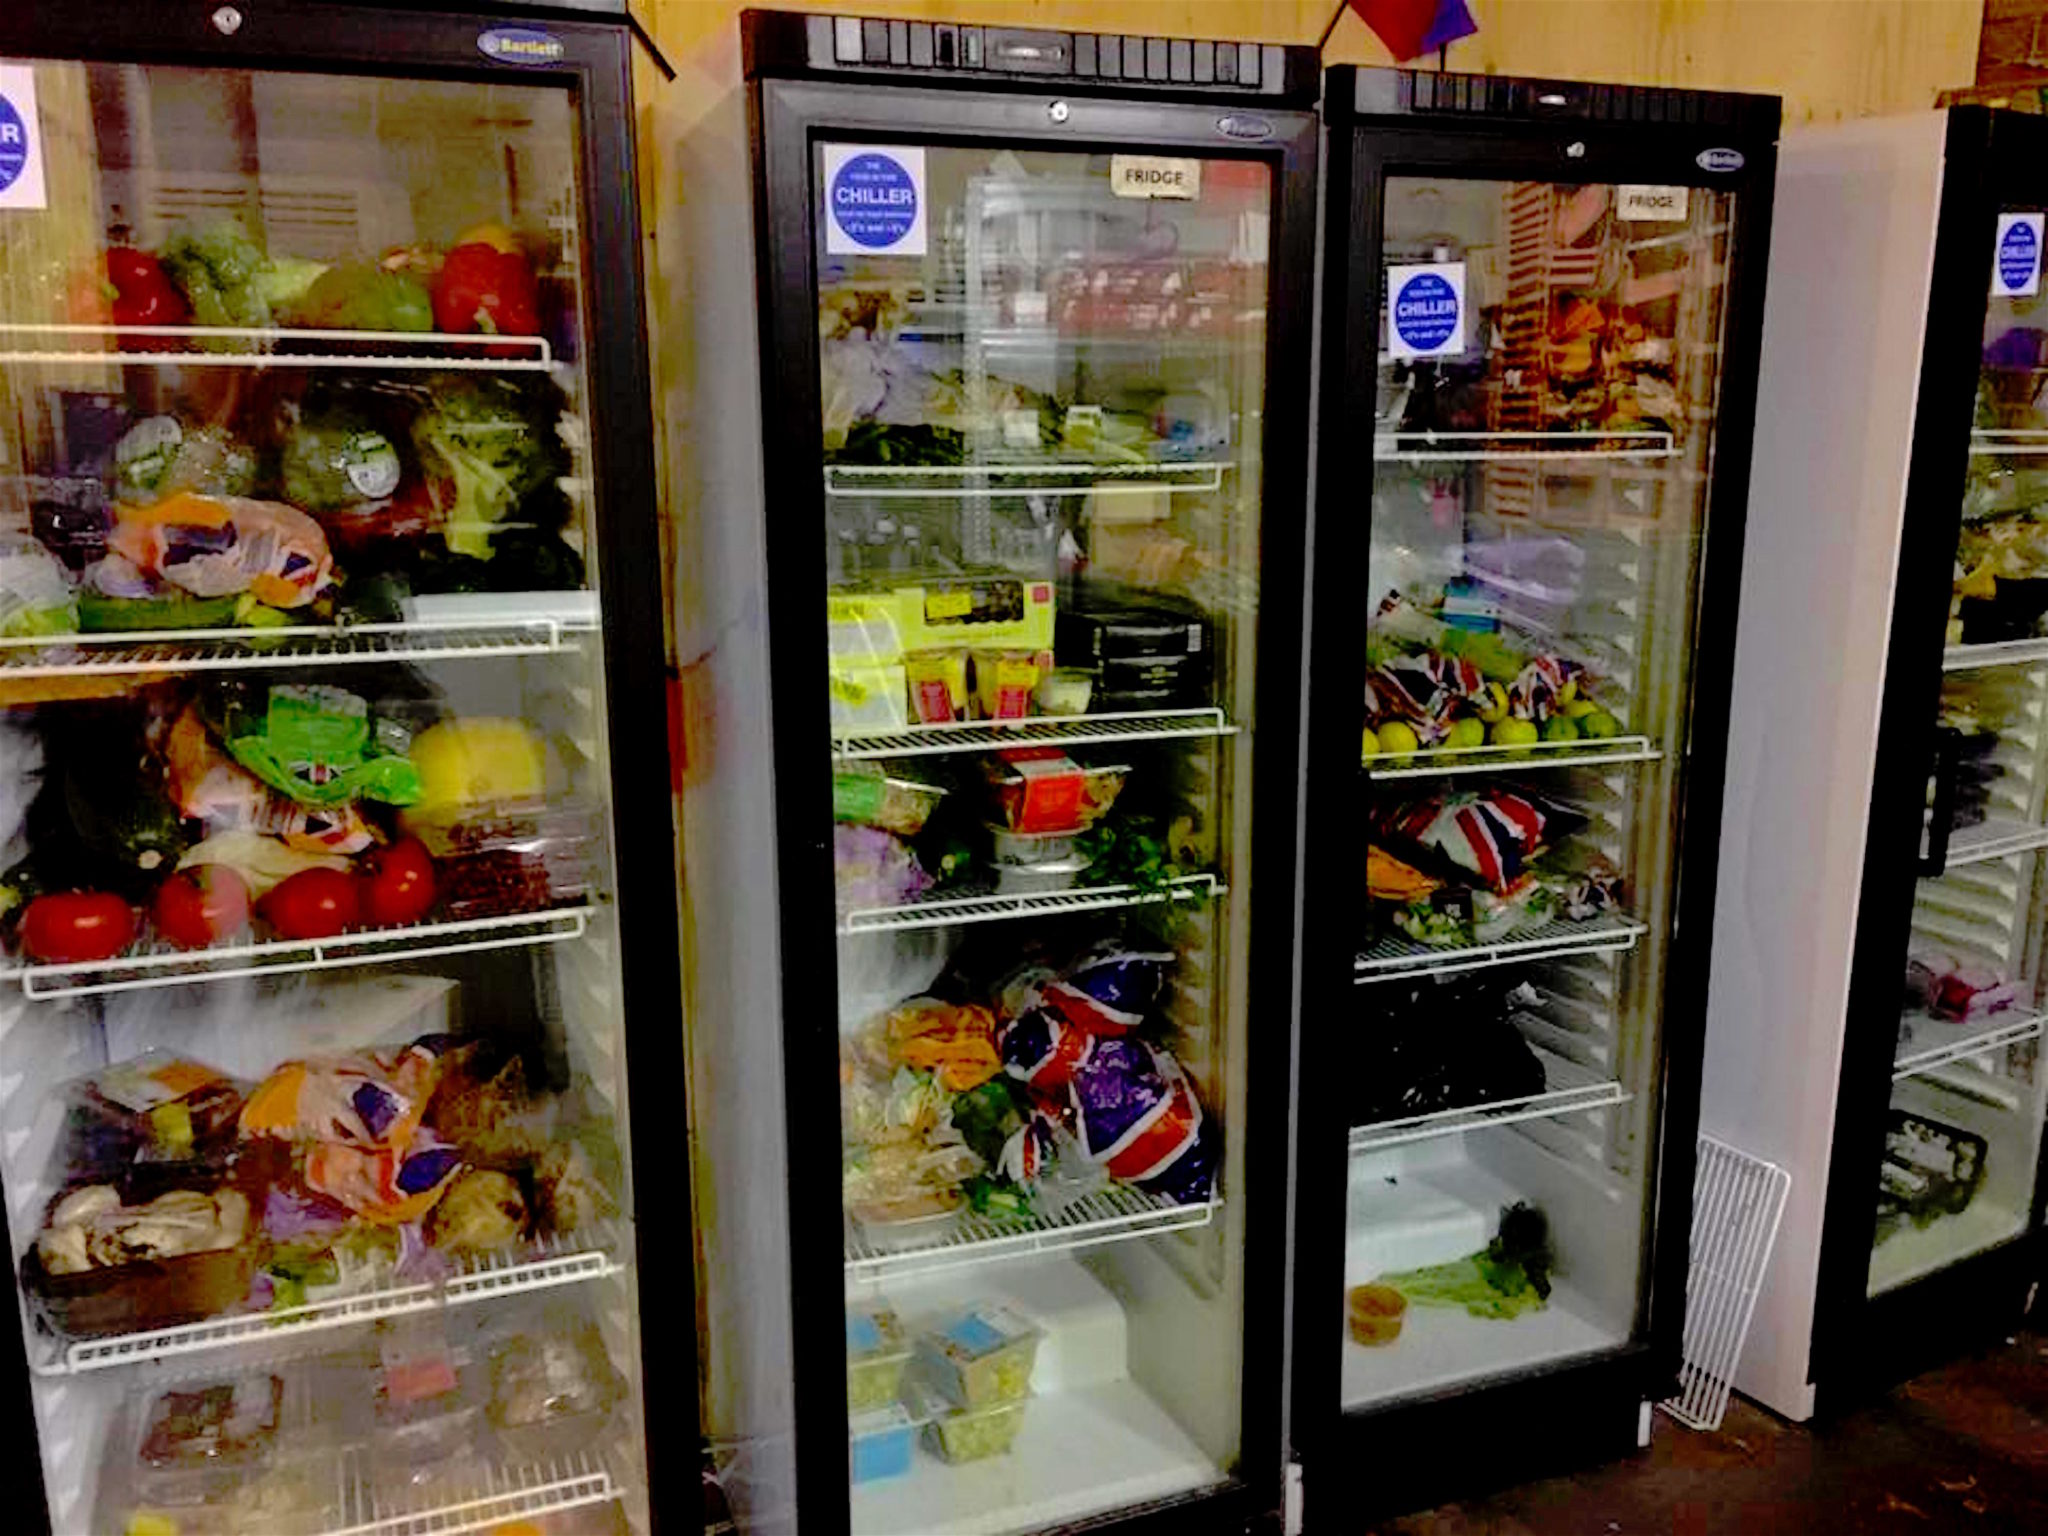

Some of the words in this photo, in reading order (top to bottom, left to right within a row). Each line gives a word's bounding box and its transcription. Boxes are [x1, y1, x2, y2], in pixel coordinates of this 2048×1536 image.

[1126, 168, 1183, 186] FRIDGE
[836, 186, 913, 205] CHILLER
[1398, 299, 1456, 317] CHILLER
